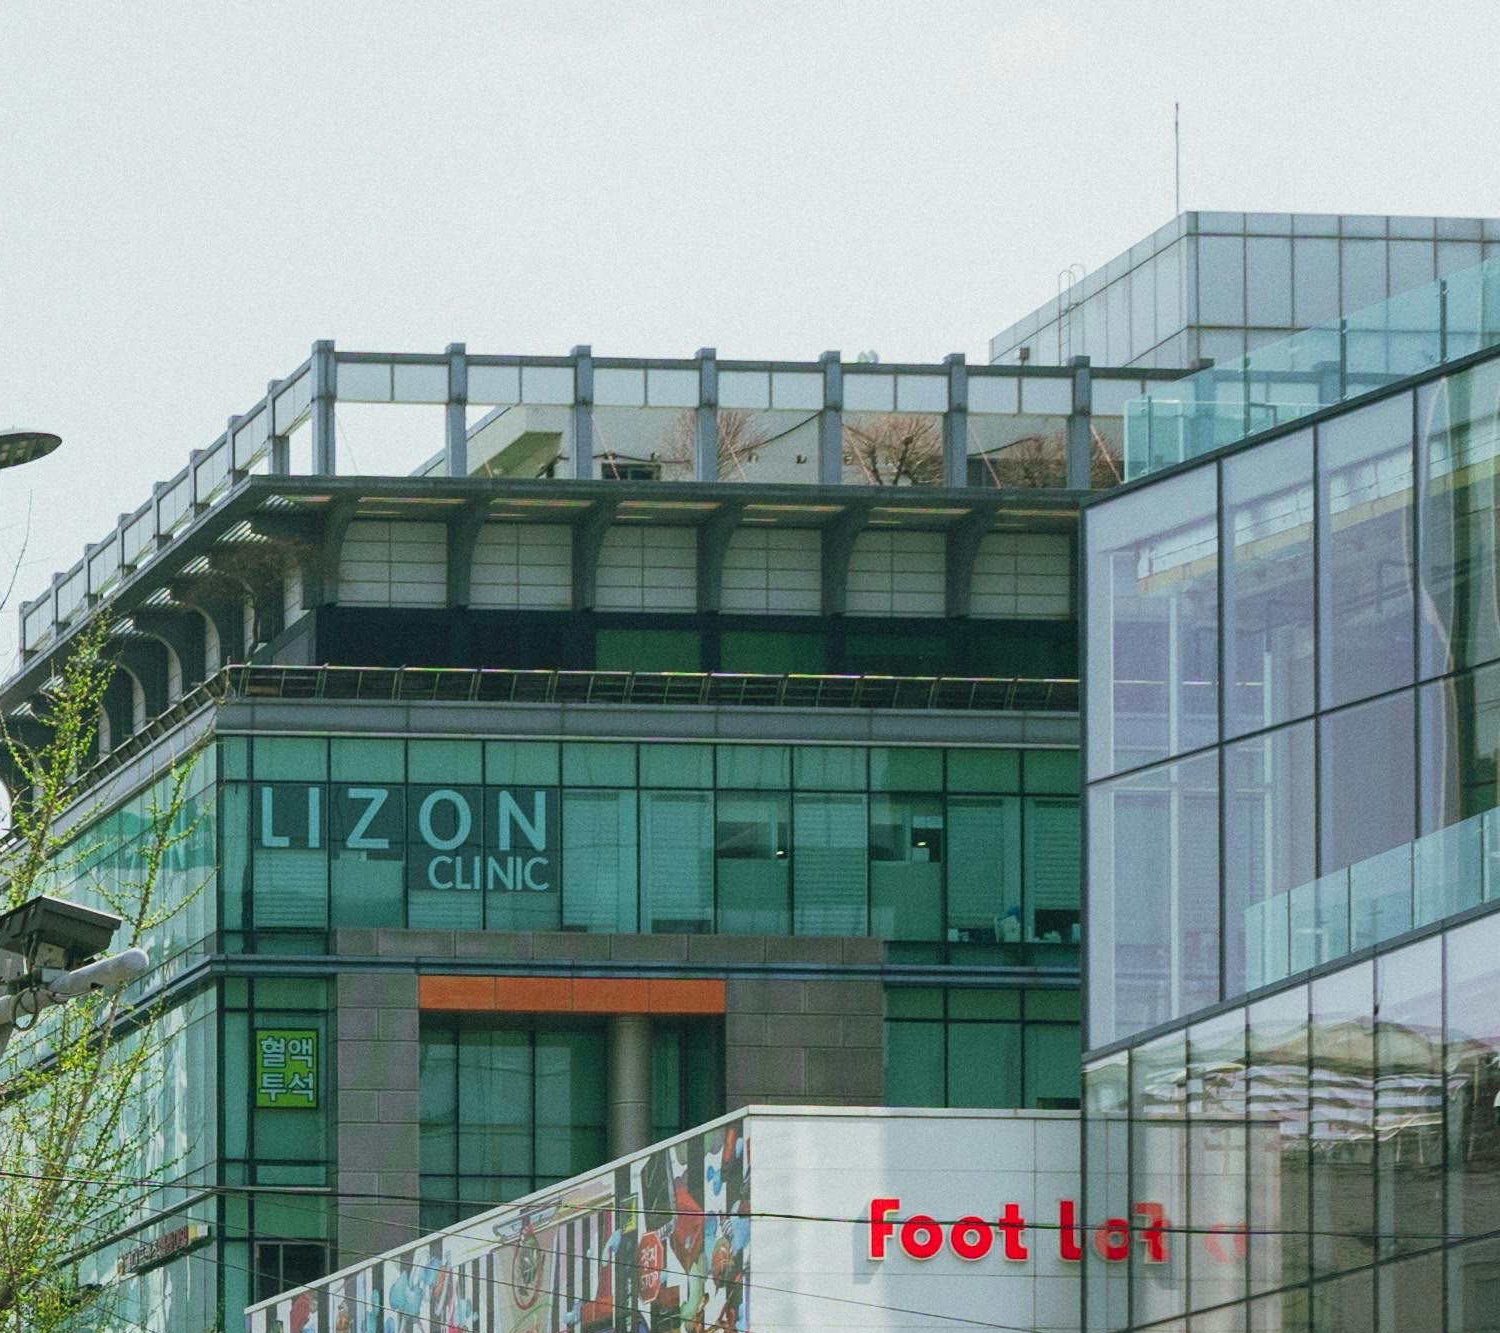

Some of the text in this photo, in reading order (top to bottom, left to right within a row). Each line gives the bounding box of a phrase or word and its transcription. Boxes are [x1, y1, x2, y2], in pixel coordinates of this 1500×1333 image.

[261, 786, 547, 852] LIZON
[427, 855, 550, 891] CLINIC
[260, 1037, 313, 1068] 혈액
[259, 1072, 314, 1102] 투석
[868, 1197, 1030, 1262] Foot
